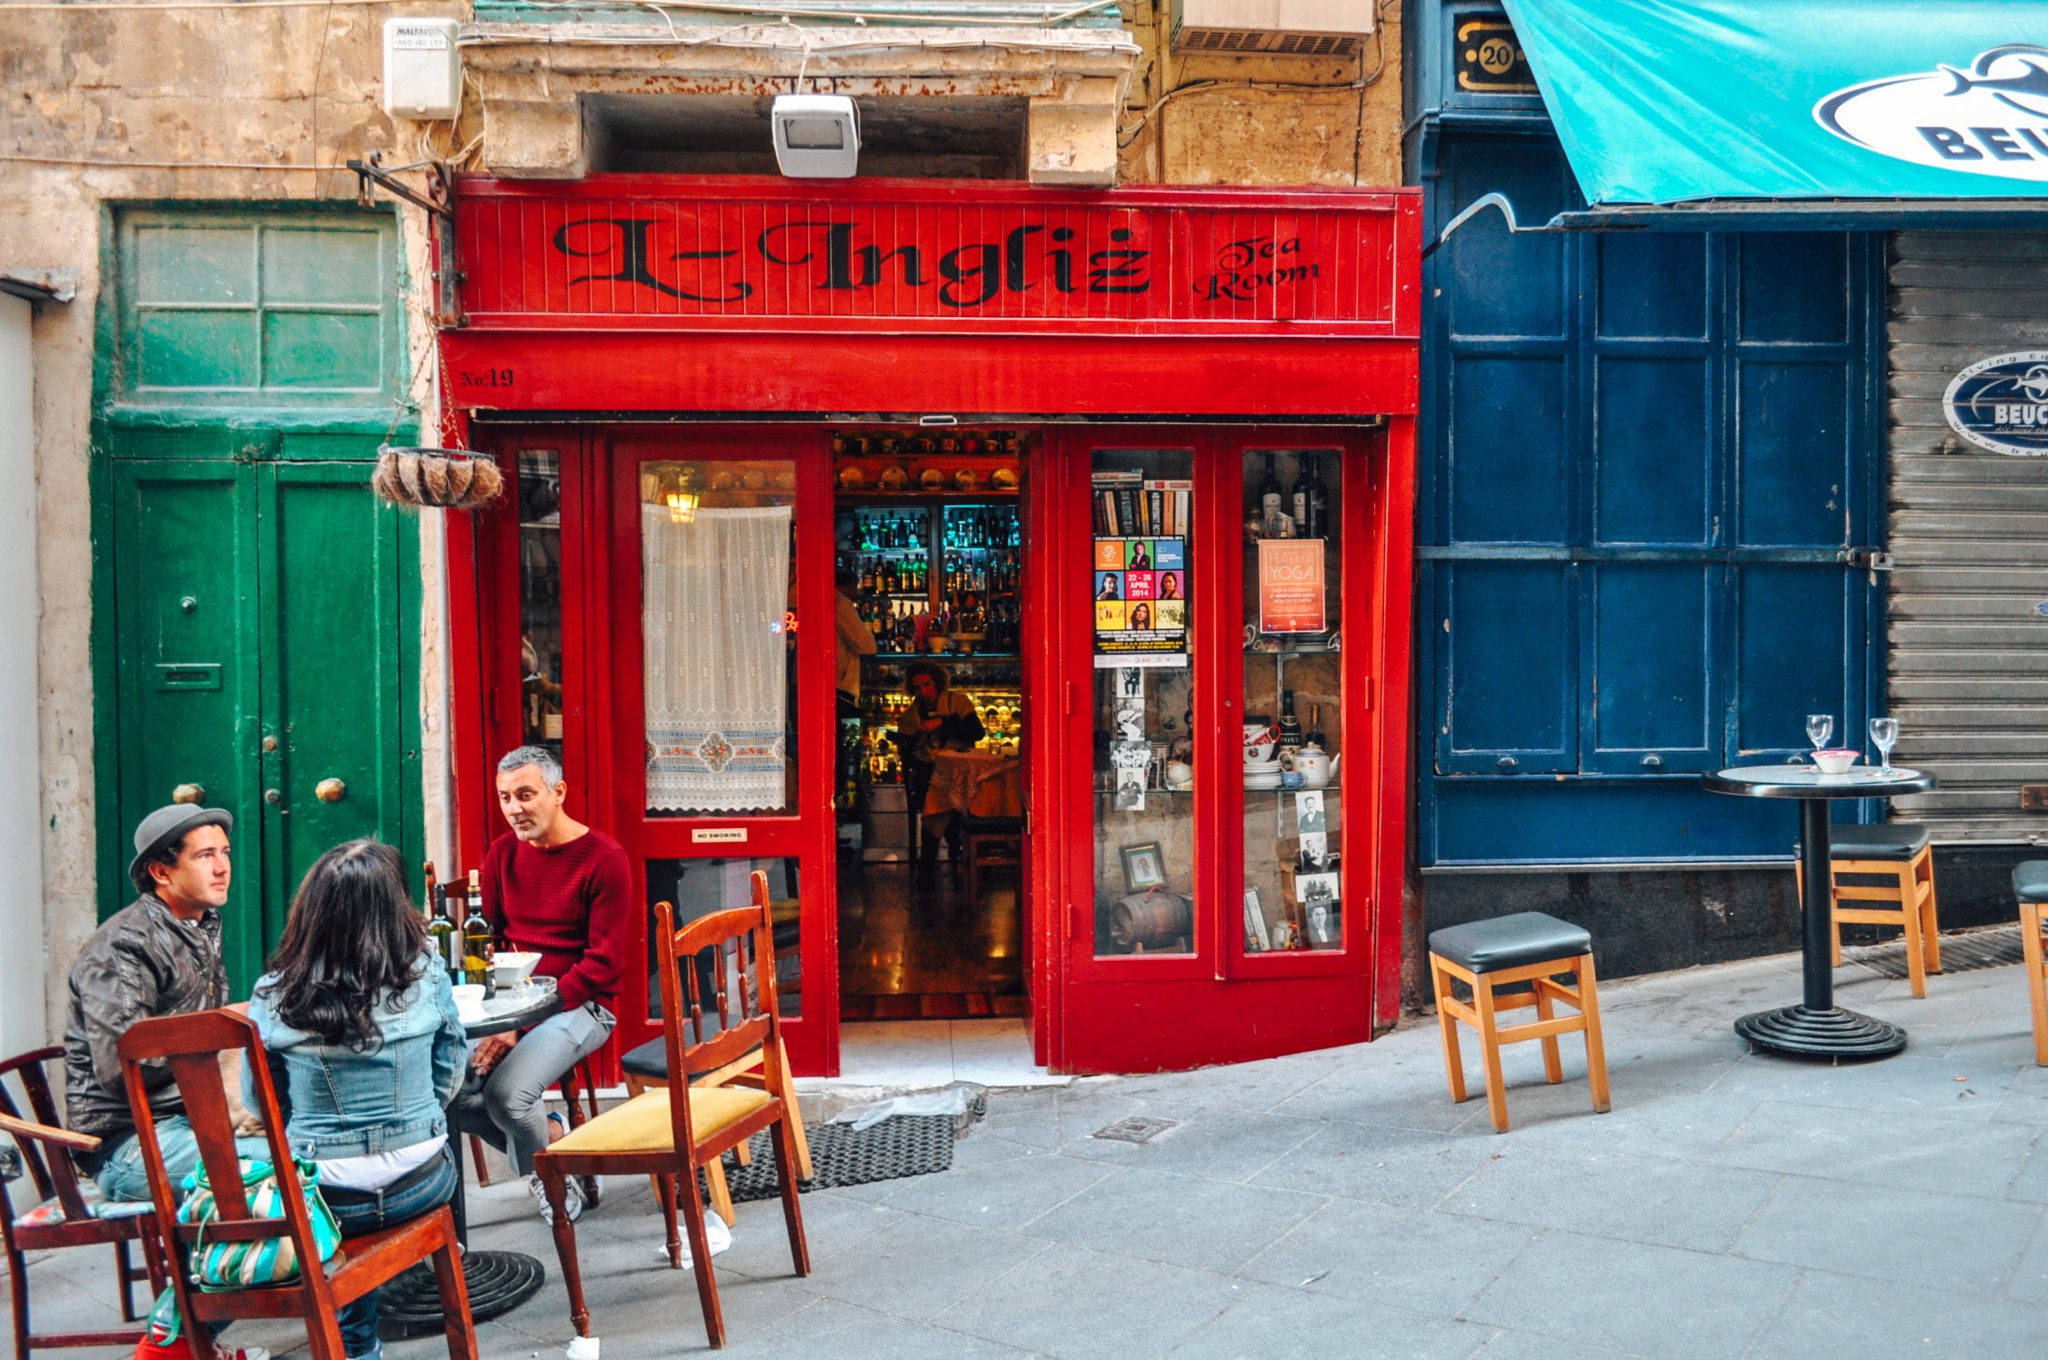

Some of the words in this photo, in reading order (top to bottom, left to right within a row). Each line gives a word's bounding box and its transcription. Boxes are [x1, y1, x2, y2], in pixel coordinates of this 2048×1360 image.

[1483, 46, 1510, 66] 20
[1218, 236, 1300, 271] Tea
[1192, 263, 1319, 301] Room
[1994, 405, 2048, 425] BEUC
[1128, 573, 1137, 581] 22
[1270, 565, 1313, 580] YOGA
[1130, 581, 1150, 589] APRIL
[1131, 589, 1149, 597] 2014
